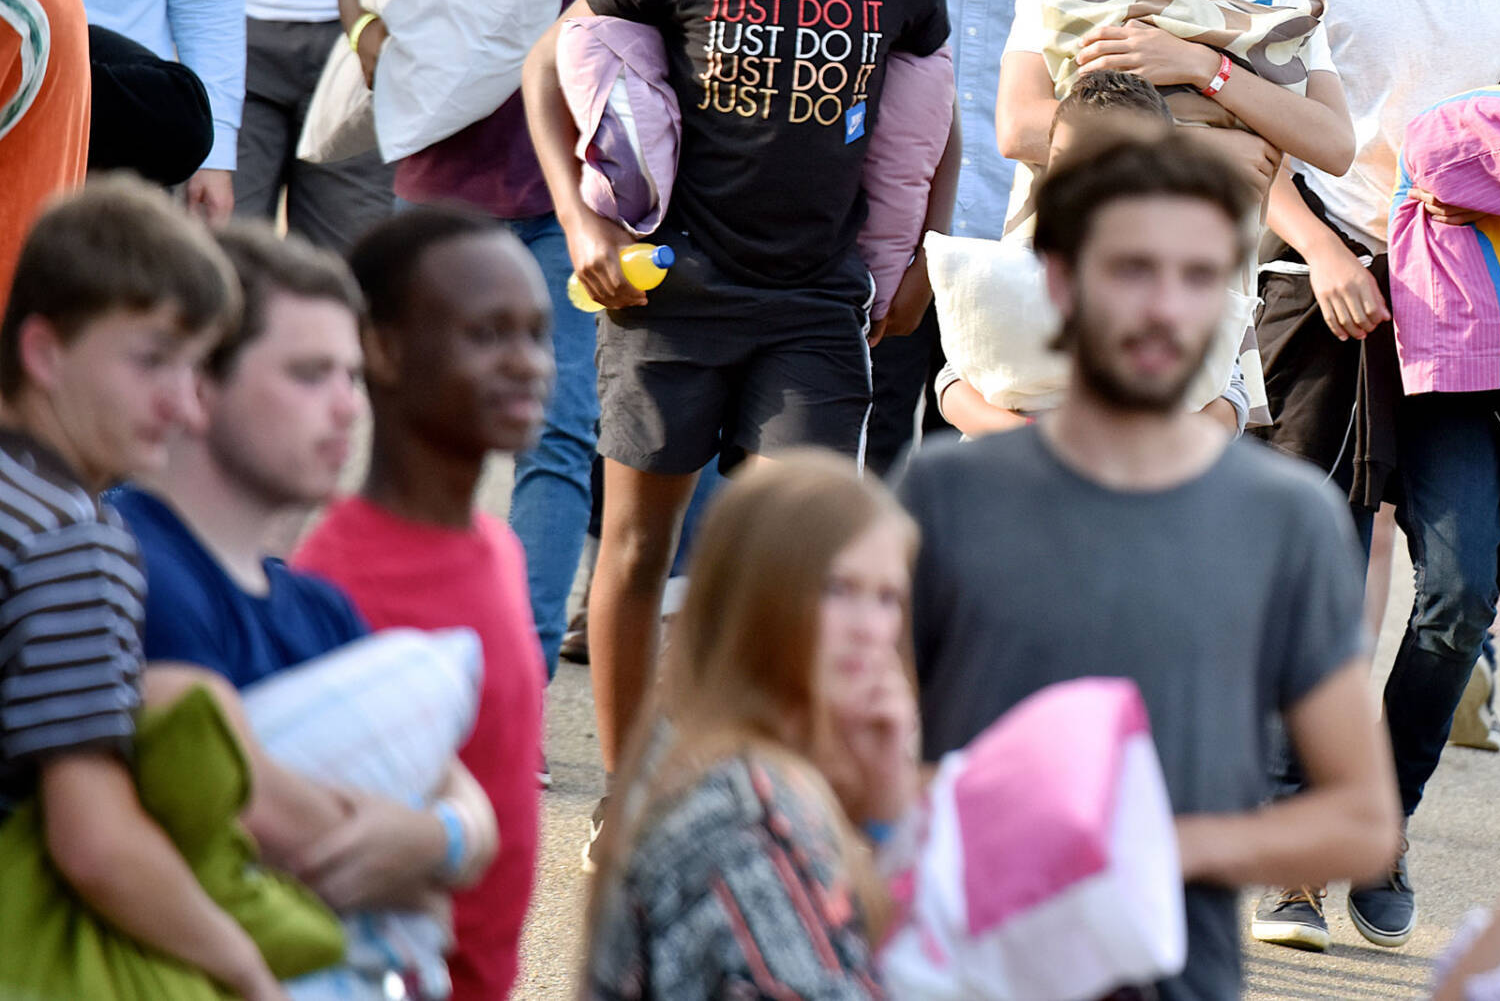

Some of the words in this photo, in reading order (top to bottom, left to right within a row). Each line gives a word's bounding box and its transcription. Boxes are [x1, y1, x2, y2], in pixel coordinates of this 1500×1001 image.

[863, 0, 884, 32] IT
[702, 20, 785, 57] JUST
[795, 27, 852, 62] DO
[861, 32, 883, 64] IT
[698, 51, 782, 88] JUST
[792, 59, 849, 94] DO
[853, 63, 876, 94] IT
[697, 79, 779, 120] JUST
[788, 91, 843, 126] DO
